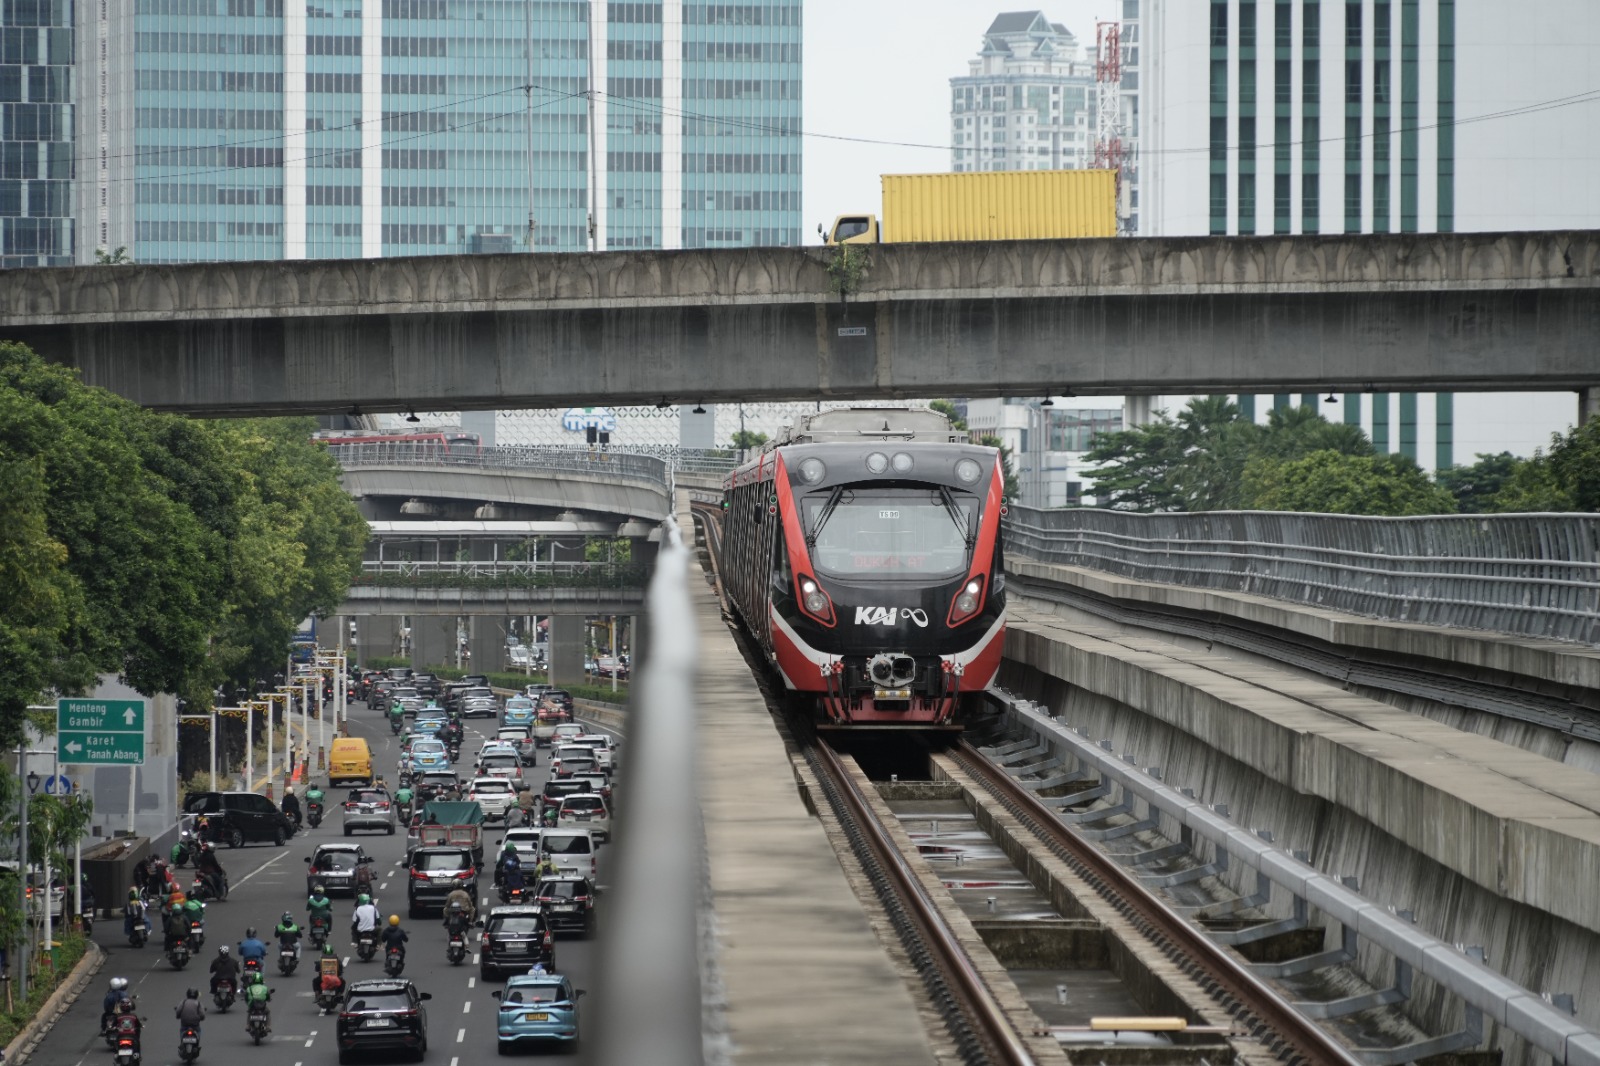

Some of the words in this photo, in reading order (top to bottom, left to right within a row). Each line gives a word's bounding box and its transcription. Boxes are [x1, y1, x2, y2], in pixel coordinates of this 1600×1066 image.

[854, 606, 898, 626] KAI
[69, 703, 106, 715] Menteng
[69, 716, 103, 727] Gambir
[86, 736, 115, 746] Karet
[86, 750, 111, 760] Tanah
[113, 750, 139, 762] Abang
